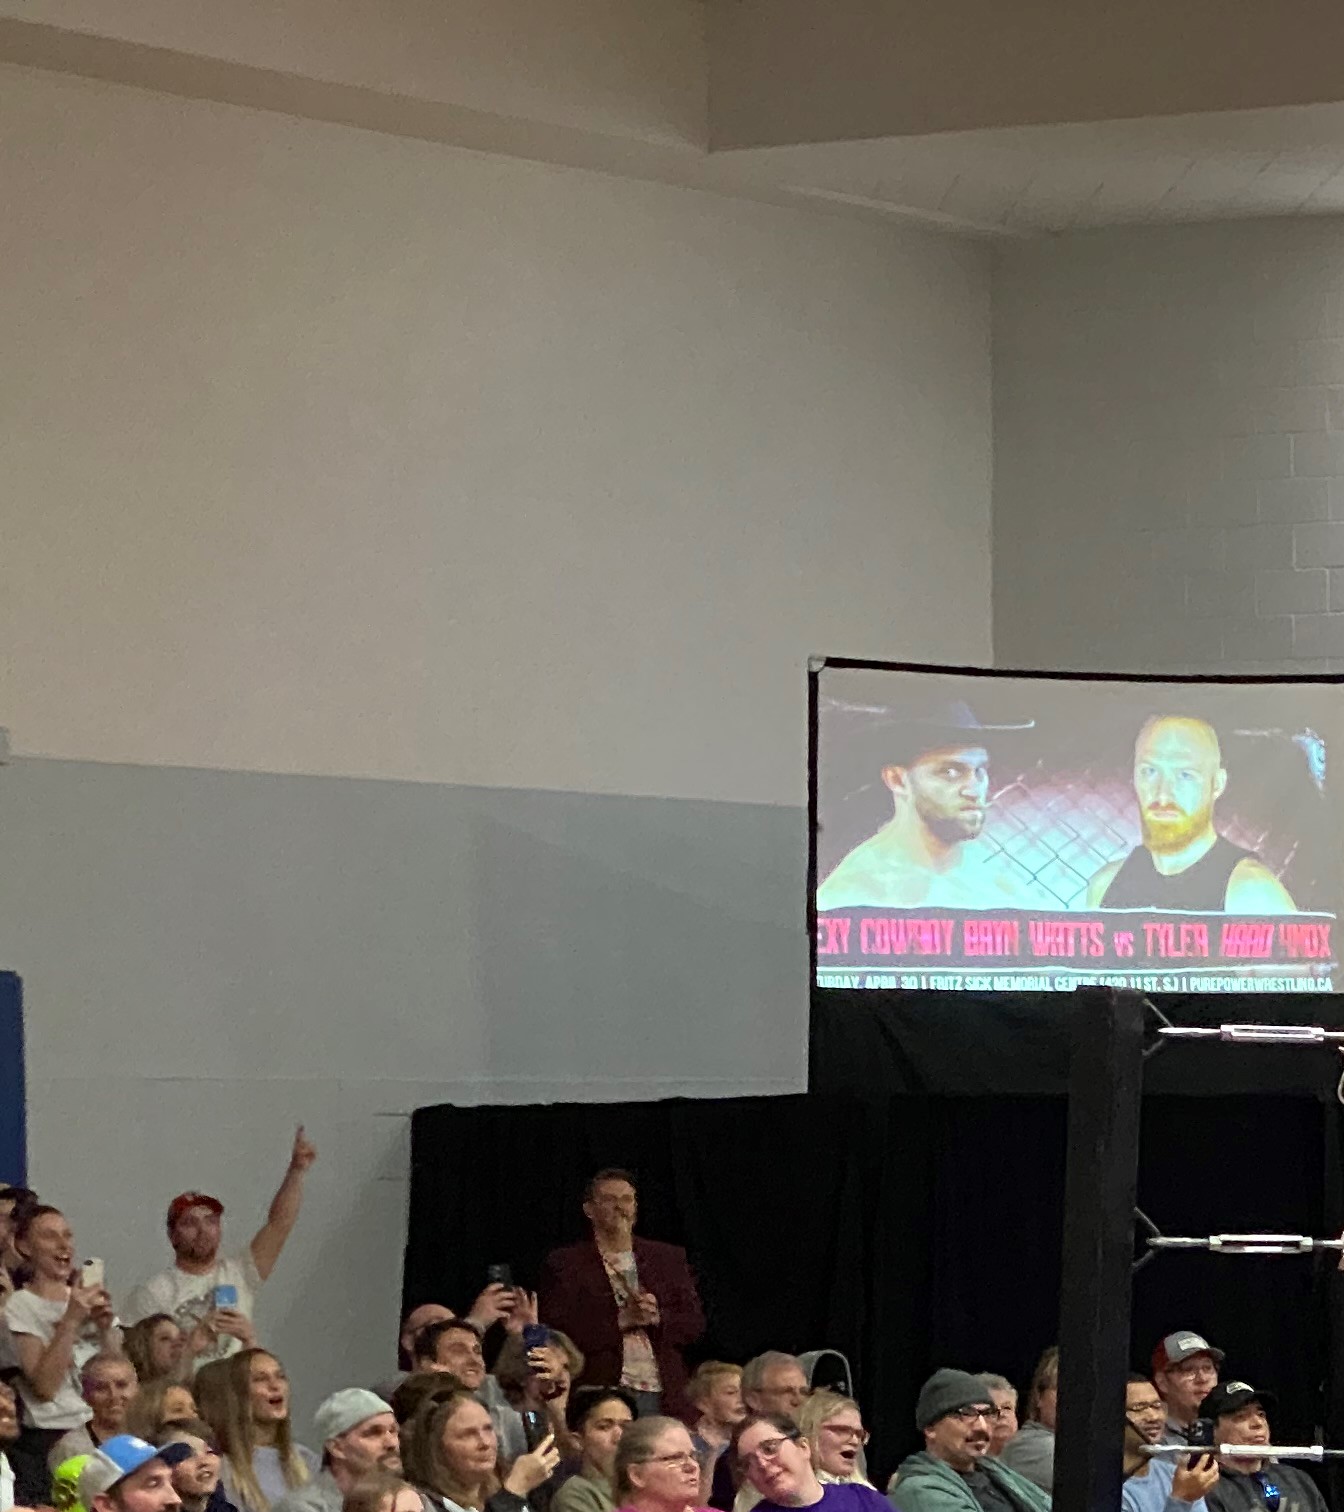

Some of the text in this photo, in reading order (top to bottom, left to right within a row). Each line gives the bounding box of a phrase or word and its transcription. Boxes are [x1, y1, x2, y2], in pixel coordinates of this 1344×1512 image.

[1028, 921, 1104, 957] WATTS
[1143, 923, 1209, 957] TYLER
[993, 976, 1053, 991] MEMORIAL
